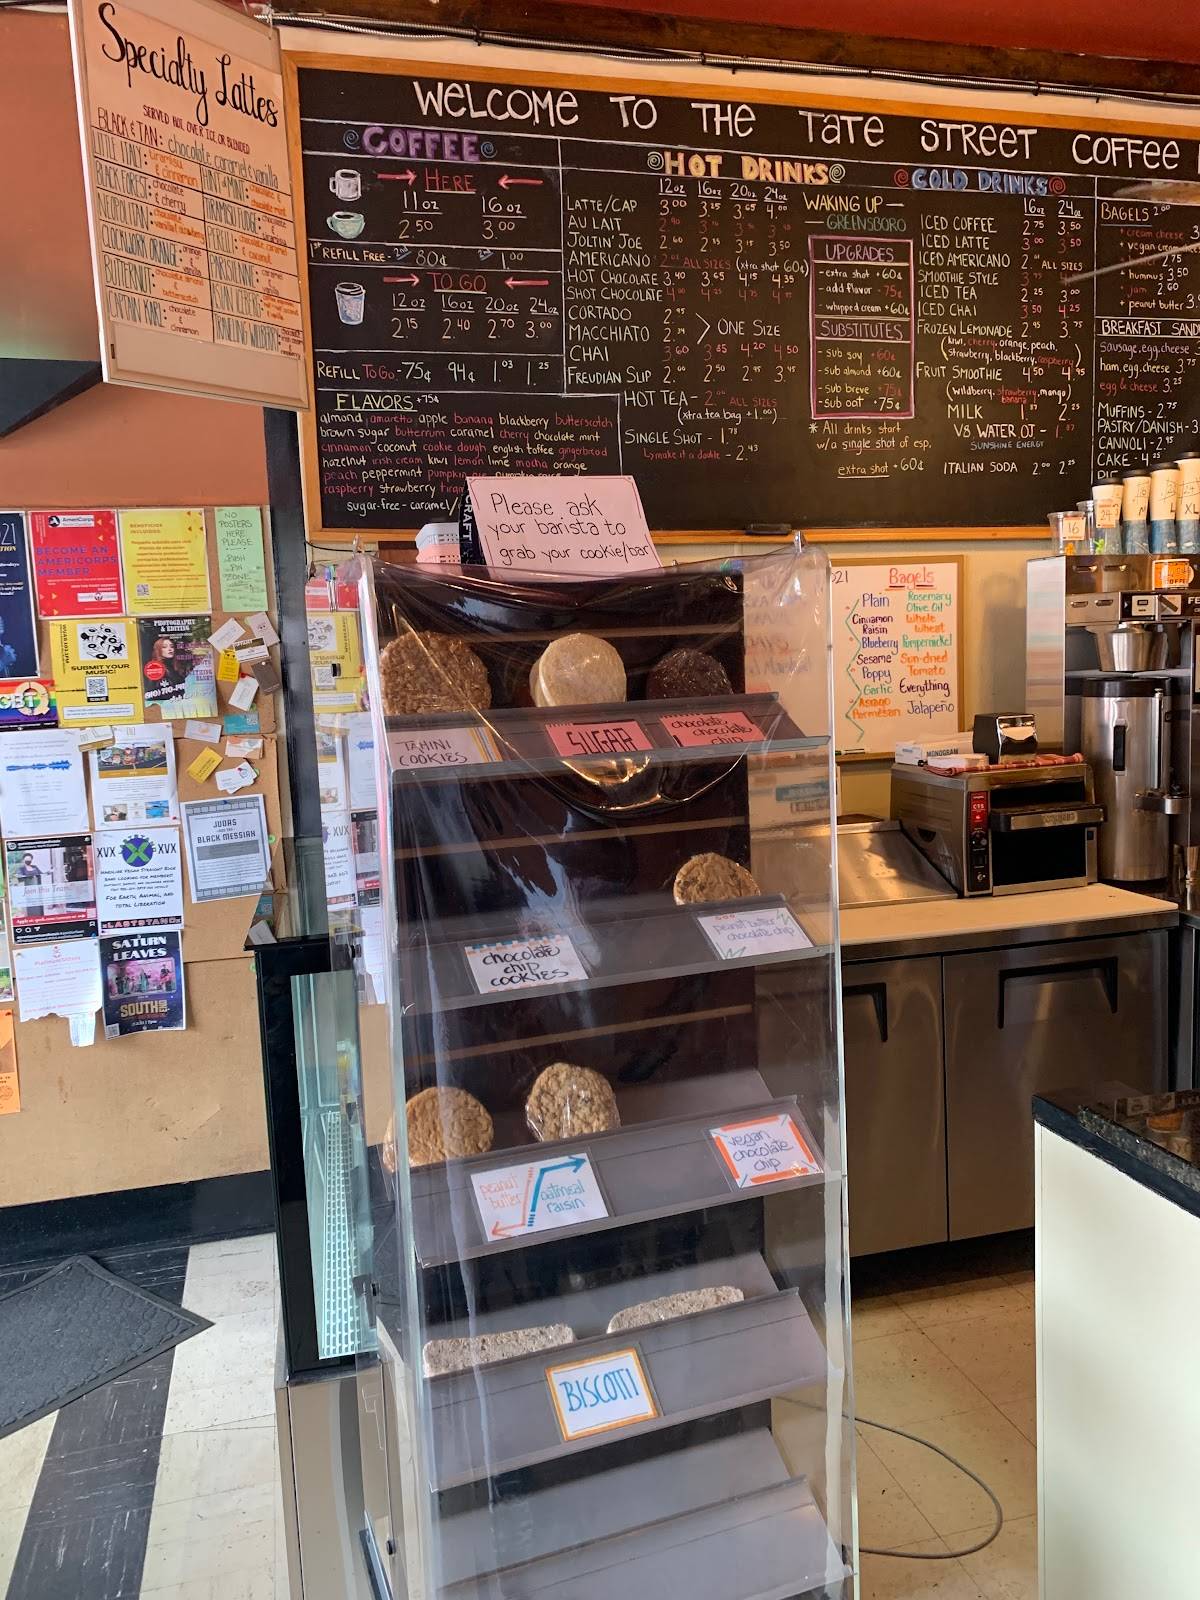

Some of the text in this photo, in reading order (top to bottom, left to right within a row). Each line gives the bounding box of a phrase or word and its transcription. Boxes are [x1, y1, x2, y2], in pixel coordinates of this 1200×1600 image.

[98, 3, 278, 127] Specialty Lattes
[98, 107, 130, 135] BLACK
[609, 96, 658, 130] TO
[187, 120, 203, 137] OVER
[362, 127, 480, 161] COFFEE
[96, 162, 120, 188] BLACK
[665, 151, 830, 185] HOT DRINKS
[424, 168, 477, 191] HERE
[911, 167, 1049, 195] COLD DRINKS
[566, 194, 638, 215] LATTE/CAP
[802, 192, 883, 214] WAKING UP
[1100, 202, 1150, 222] BAGELS
[592, 217, 622, 232] LAIT
[826, 214, 907, 232] GREENSBORO
[921, 214, 998, 234] ICED COFFEE
[619, 236, 643, 251] JOE
[955, 236, 990, 251] LATTE
[322, 247, 360, 262] REFILL
[568, 251, 651, 268] AMERICANO
[825, 244, 895, 262] UPGRADES
[919, 251, 1012, 268] ICED AMERICANO
[426, 272, 488, 292] TO GO
[567, 269, 659, 287] HOT CHOCOLATE
[825, 268, 870, 279] extra shot
[568, 306, 632, 321] CORTADO
[568, 325, 651, 343] MACCHIATO
[717, 318, 781, 338] ONE SIZE
[820, 321, 904, 340] SUBSTITUTES
[917, 318, 1013, 339] FROZEN LEMONADE
[1101, 319, 1162, 336] BREAKFAST
[568, 345, 610, 362] CHAI
[317, 361, 360, 380] REFILL
[567, 366, 652, 385] FREUDIAN SLIP
[916, 362, 1003, 382] FRUIT SMOOTHIE
[335, 393, 415, 411] FLAVORS
[624, 390, 689, 408] HOT TEA
[846, 397, 864, 408] oat
[947, 403, 984, 420] MILK
[1097, 402, 1145, 419] MUFFINS
[320, 413, 549, 431] almond apple blackberry
[844, 423, 872, 435] drinks
[319, 426, 355, 440] brown
[357, 427, 390, 445] sugar
[450, 427, 495, 440] caramel
[579, 430, 601, 443] mint
[625, 429, 703, 445] SINGLE SHOT
[1098, 436, 1147, 452] CANNOLI
[377, 441, 417, 454] coconut
[322, 456, 367, 469] hazelnut
[487, 455, 510, 468] lime
[553, 459, 587, 476] orange
[943, 461, 1019, 475] ITALIAN SODA
[1097, 453, 1132, 467] CAKE
[361, 467, 422, 486] peppermint
[378, 478, 435, 498] strawberry
[490, 492, 604, 518] Please ask
[488, 518, 627, 541] your barista to
[1068, 522, 1080, 536] 16
[36, 546, 87, 555] BECOME
[499, 542, 650, 567] grab your cookie/bar
[889, 567, 936, 591] Bagels
[862, 593, 890, 608] Plain
[852, 613, 894, 625] Cinnamon
[862, 624, 888, 635] Raisin
[862, 638, 899, 656] Blueberry
[71, 664, 100, 672] SUBMIT
[856, 654, 892, 665] Sesame
[862, 667, 892, 684] Poppy
[909, 665, 946, 676] Tomato
[899, 677, 951, 698] Everything
[907, 699, 955, 720] Jalapeño
[395, 739, 452, 755] TAHINI
[567, 727, 638, 755] SUGAR
[197, 835, 220, 844] BLACK
[97, 843, 177, 858] XVX XVX
[112, 936, 167, 950] SATURN
[113, 948, 167, 961] LEAVES
[482, 943, 561, 966] chocolate
[503, 961, 540, 977] chip
[120, 1000, 159, 1018] SOUTH
[733, 1139, 794, 1162] chocolate
[753, 1155, 781, 1173] chip
[540, 1180, 584, 1202] oatmeal
[546, 1196, 586, 1214] raisin
[559, 1368, 639, 1412] BISCOTTI
